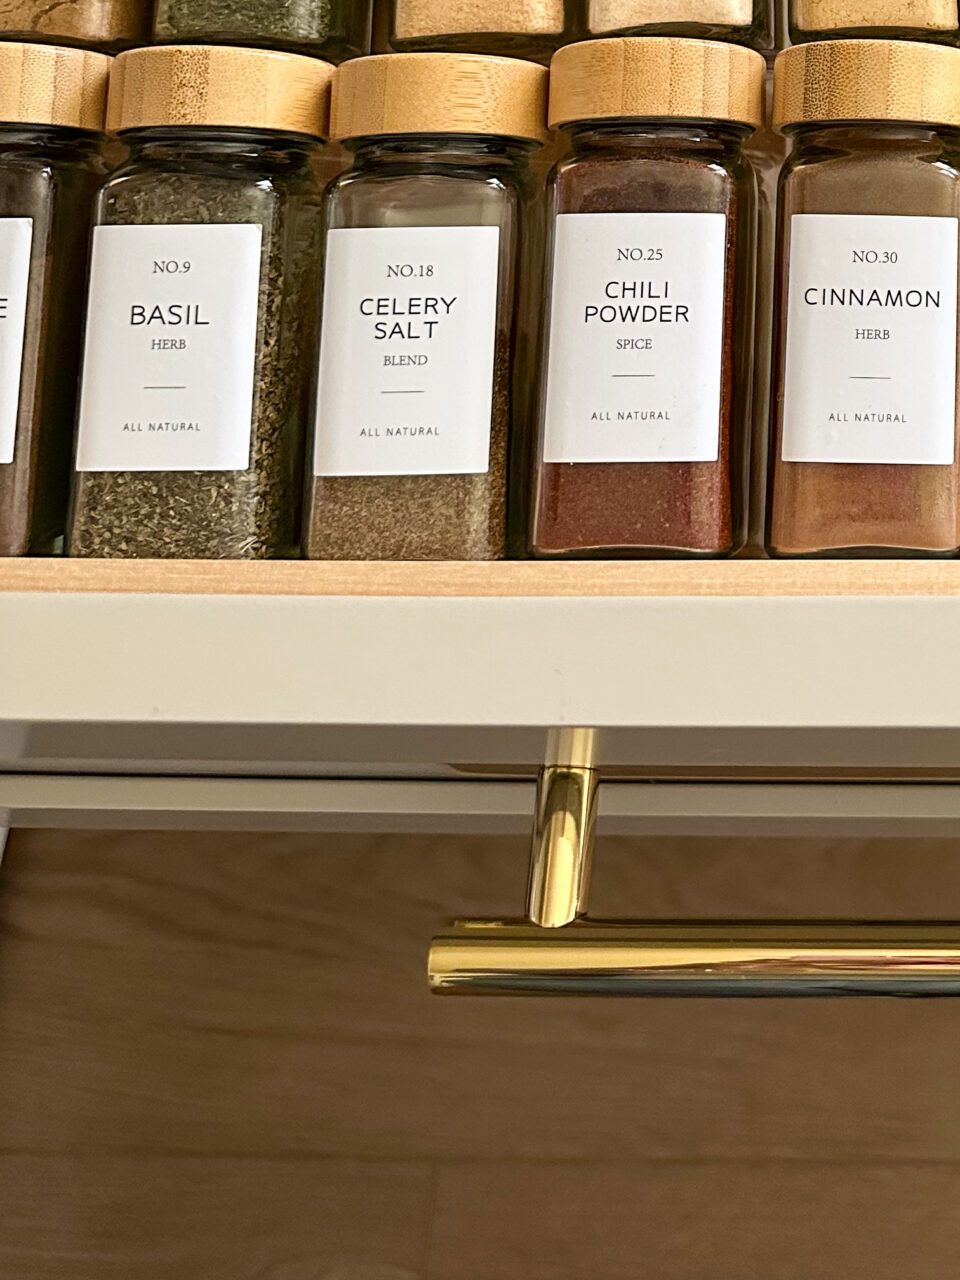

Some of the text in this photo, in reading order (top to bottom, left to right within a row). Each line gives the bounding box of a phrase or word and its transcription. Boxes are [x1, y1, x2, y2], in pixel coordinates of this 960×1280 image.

[616, 247, 663, 262] NO.25
[851, 249, 899, 265] NO.30
[151, 260, 192, 275] NO.9
[385, 263, 434, 278] NO.18
[604, 280, 669, 300] CHILI
[803, 287, 941, 309] CINNAMON
[359, 296, 458, 317] CELERY
[584, 304, 690, 324] POWDER
[129, 304, 211, 326] BASIL
[373, 320, 440, 341] SALT
[854, 328, 891, 341] HERB
[150, 338, 187, 351] HERB
[615, 338, 653, 351] SPICE
[382, 354, 429, 367] BLEND
[590, 410, 671, 422] ALL NATURAL
[828, 412, 908, 424] ALL NATURAL
[122, 421, 201, 433] ALL NATURAL
[359, 426, 440, 438] ALL NATURAL
